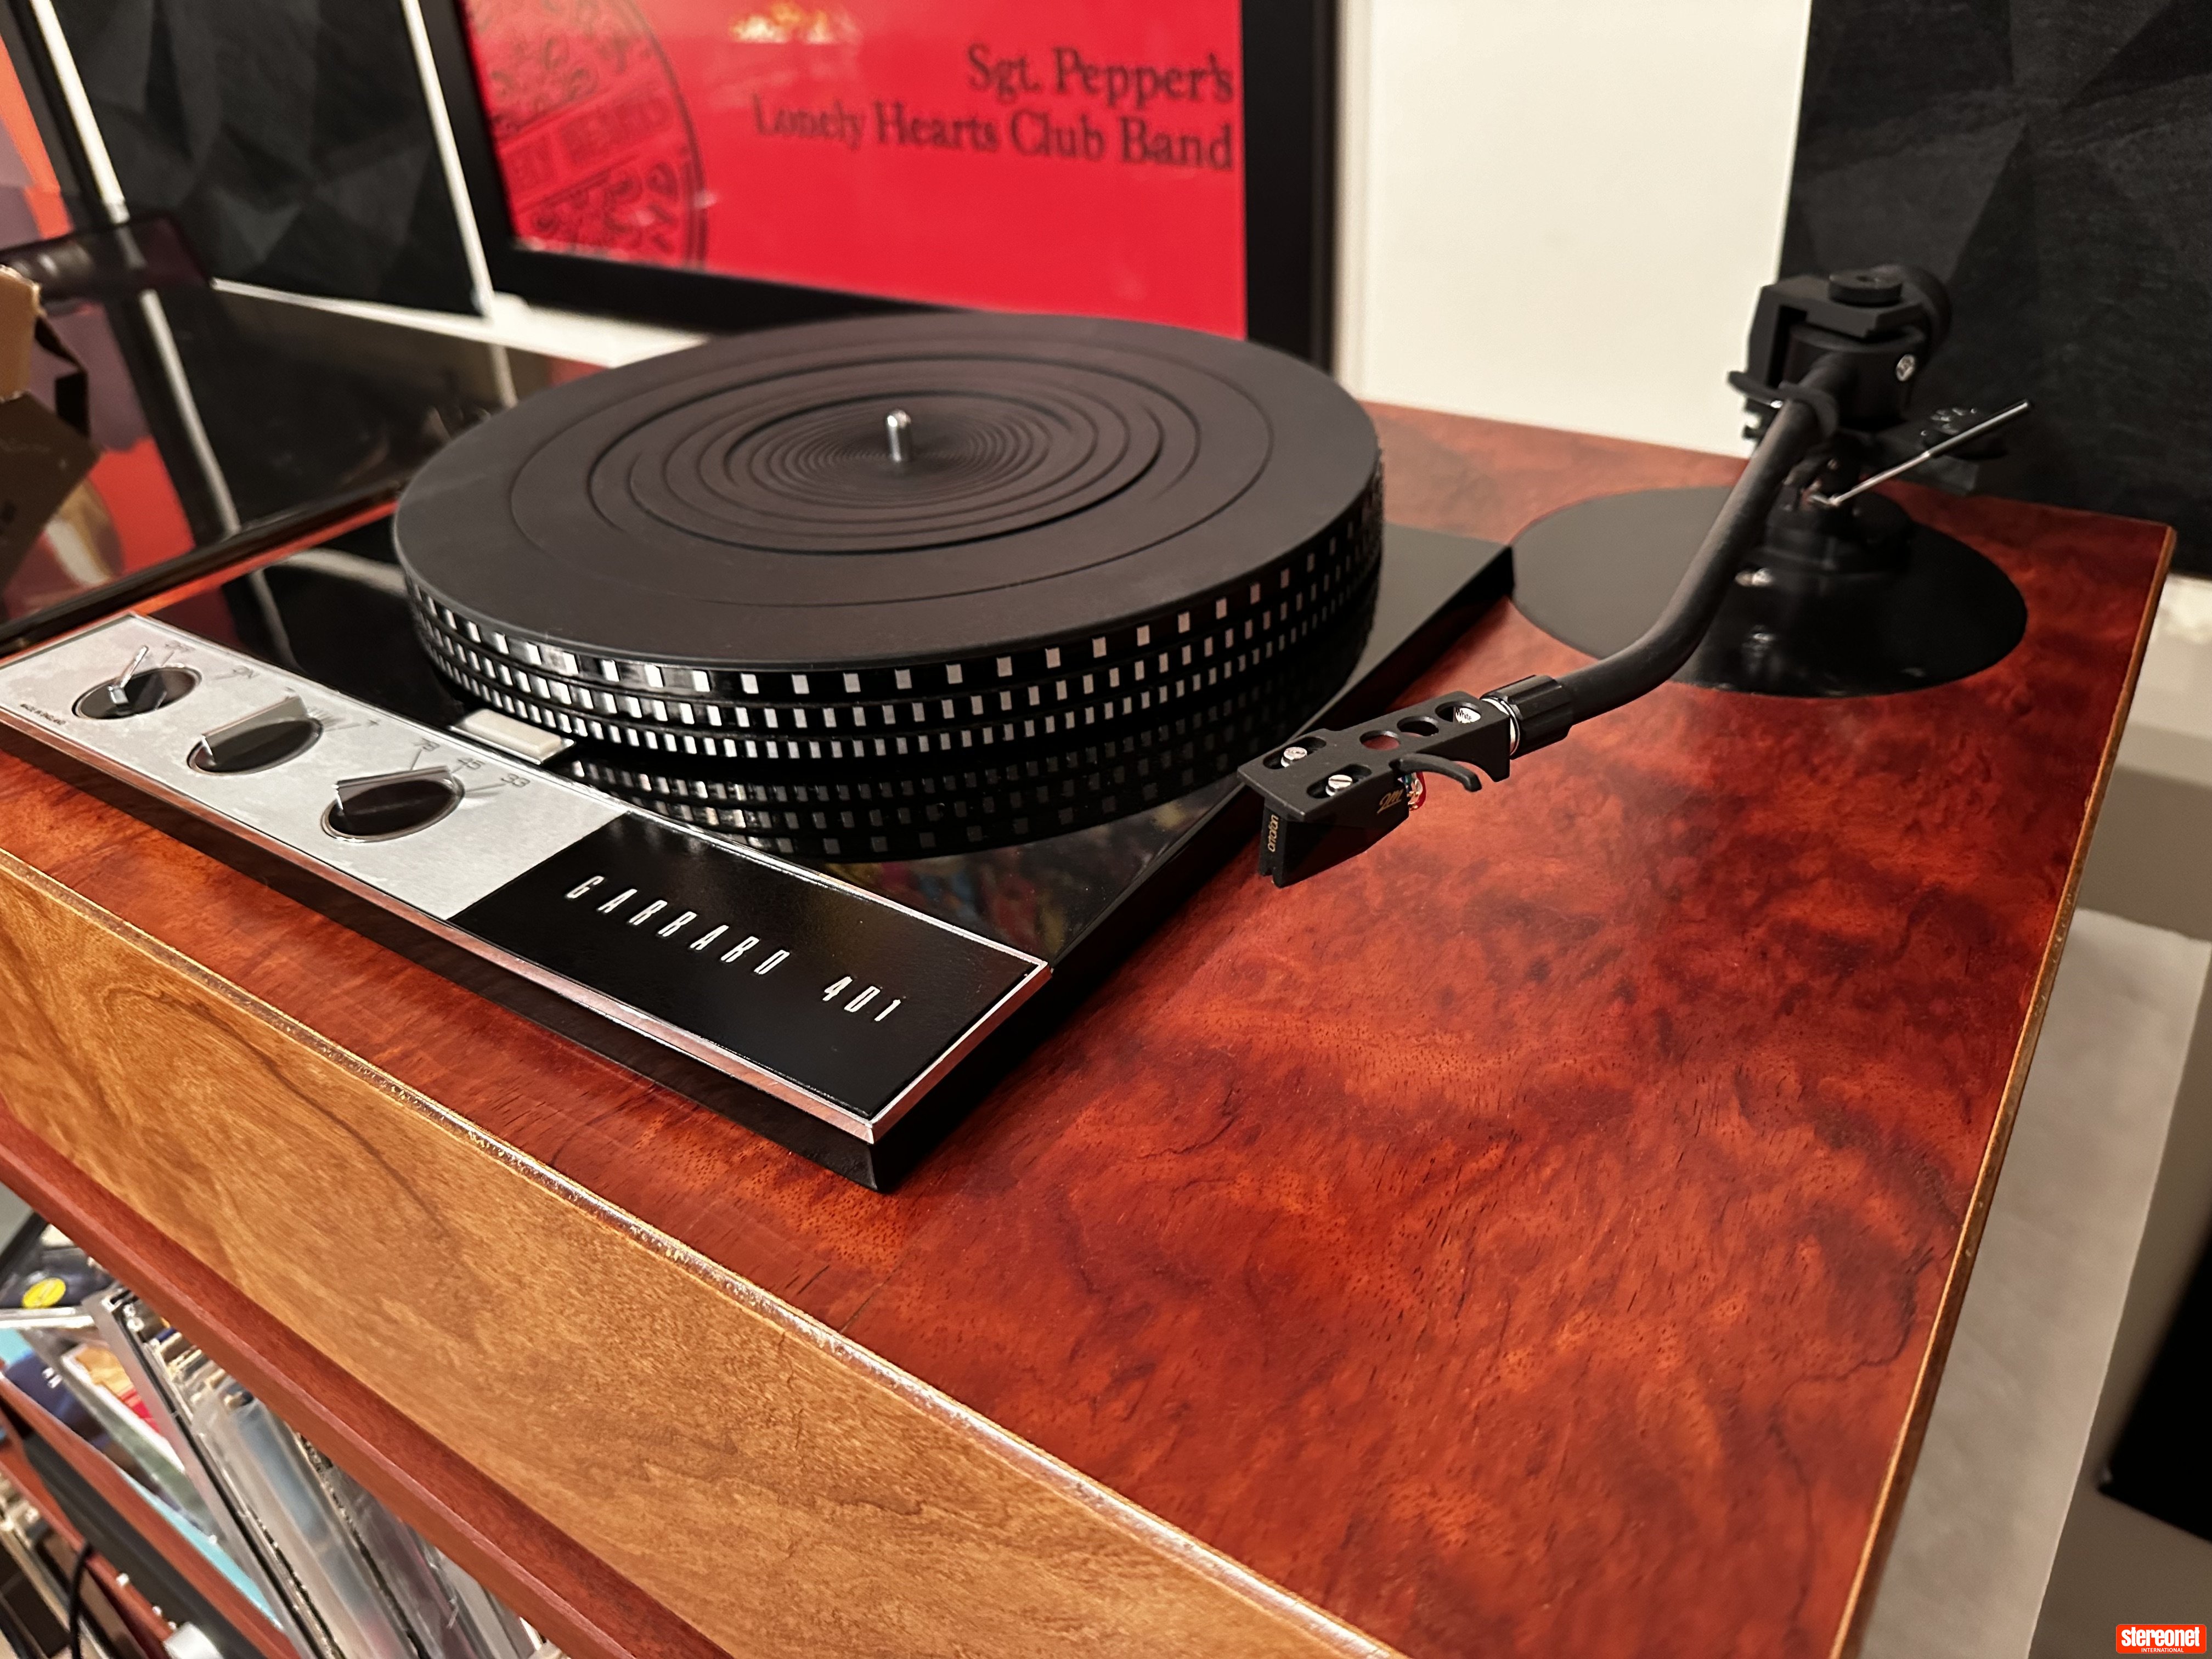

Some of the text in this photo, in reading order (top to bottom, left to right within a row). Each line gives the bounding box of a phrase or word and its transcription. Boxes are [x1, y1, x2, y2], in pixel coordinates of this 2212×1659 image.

[967, 42, 1234, 108] Sgt. Pepper's
[751, 91, 1232, 170] Lonely Hearts Club Band
[457, 756, 486, 770] 45
[500, 772, 531, 788] 33
[1267, 814, 1279, 853] ortofon
[565, 875, 902, 1022] GARRARD 401
